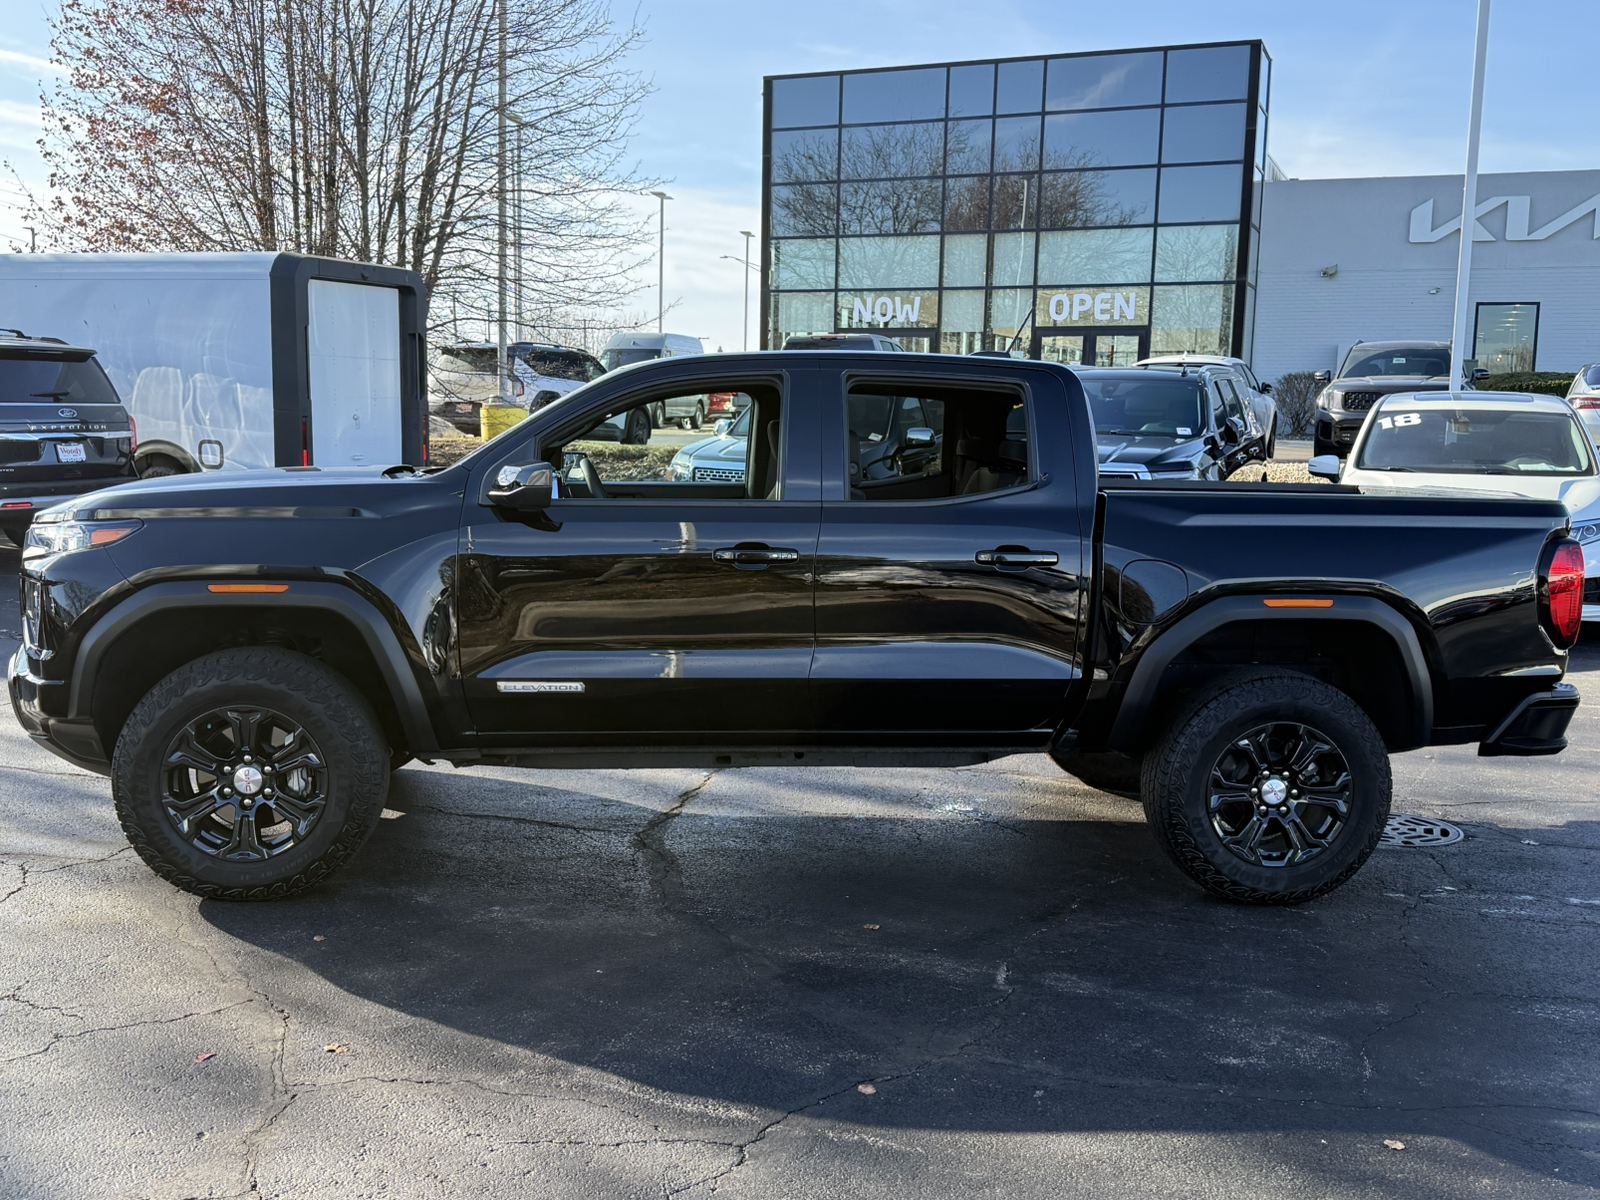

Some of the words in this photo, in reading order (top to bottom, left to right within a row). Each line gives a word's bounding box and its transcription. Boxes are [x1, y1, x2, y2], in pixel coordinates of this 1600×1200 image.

[1409, 193, 1600, 243] KIA
[853, 296, 921, 323] NOW
[1049, 292, 1136, 321] OPEN
[1377, 412, 1422, 430] 18
